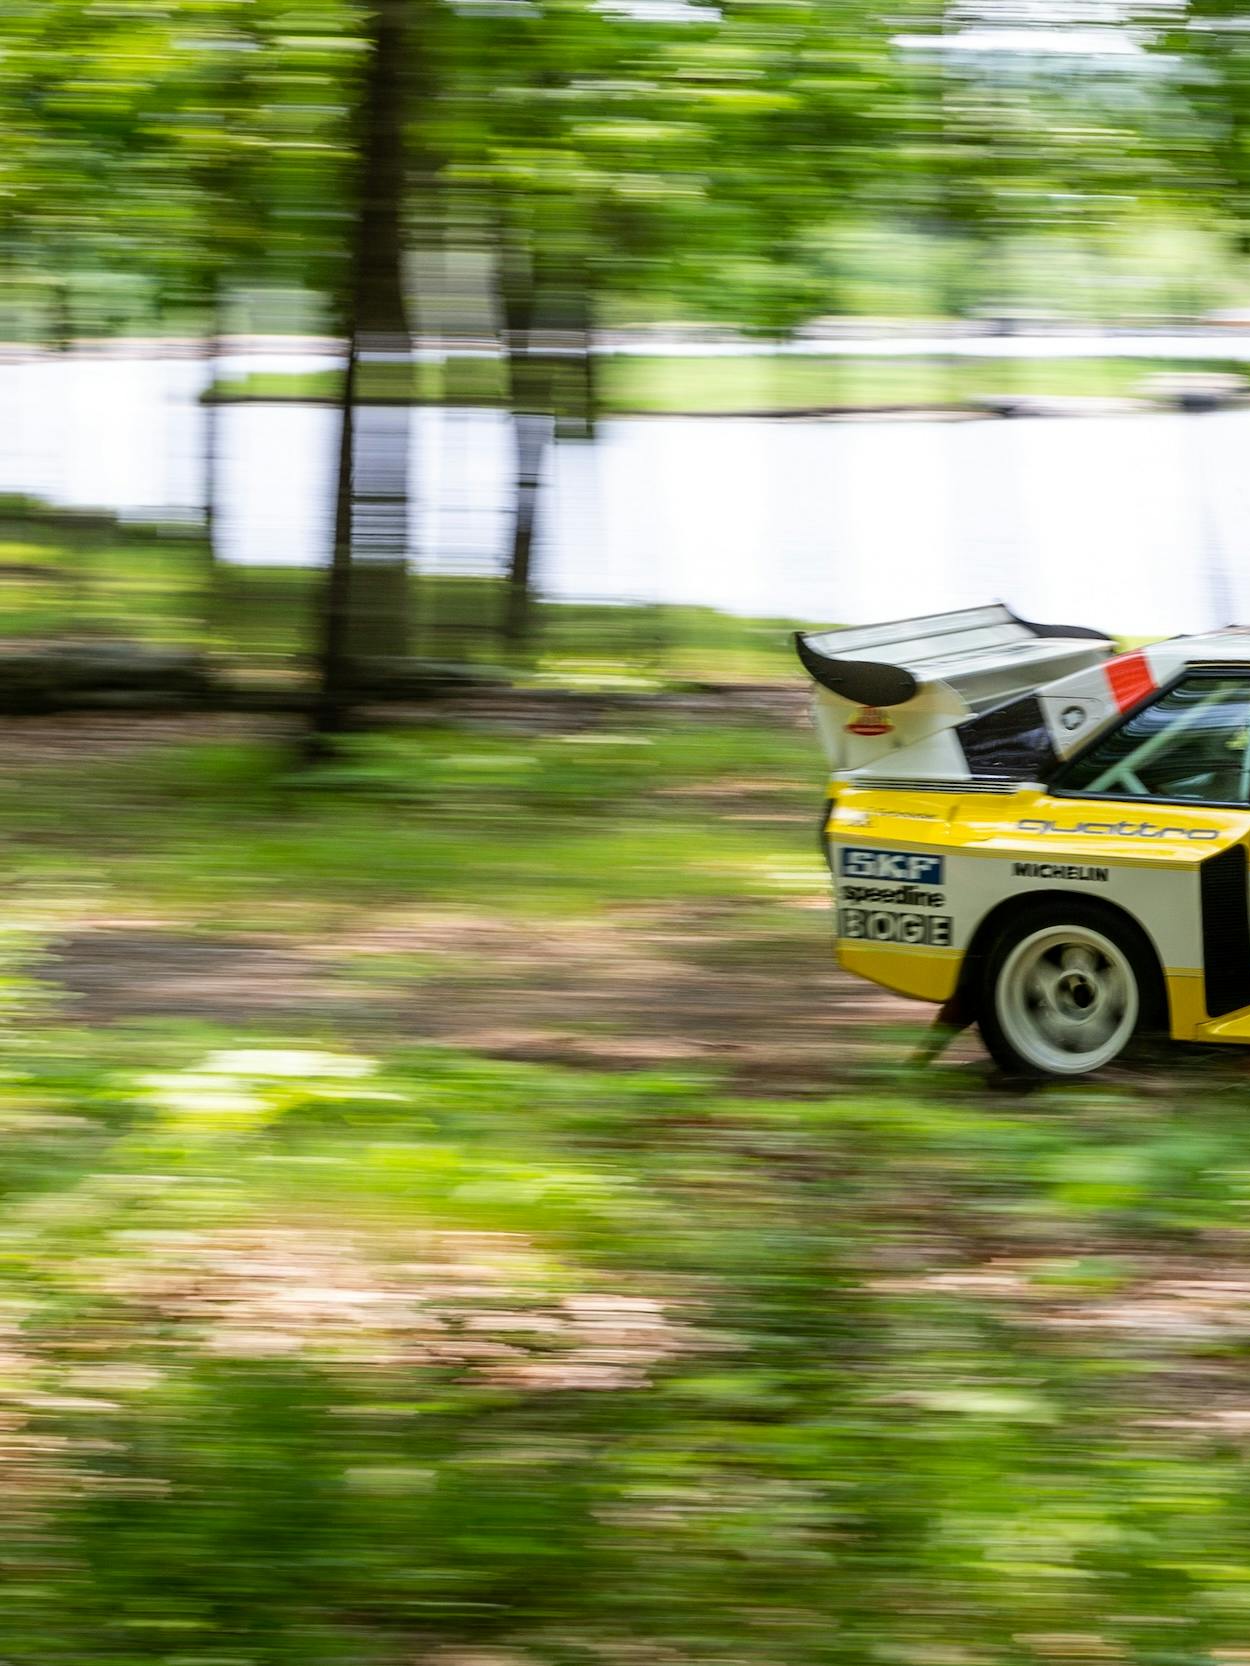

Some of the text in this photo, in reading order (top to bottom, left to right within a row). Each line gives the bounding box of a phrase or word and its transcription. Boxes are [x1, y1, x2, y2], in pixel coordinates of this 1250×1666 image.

[1018, 819, 1218, 841] quattro
[846, 851, 940, 880] SKF
[1012, 863, 1109, 882] MICHELIN
[842, 885, 946, 908] speedline
[843, 909, 951, 945] BOGE
